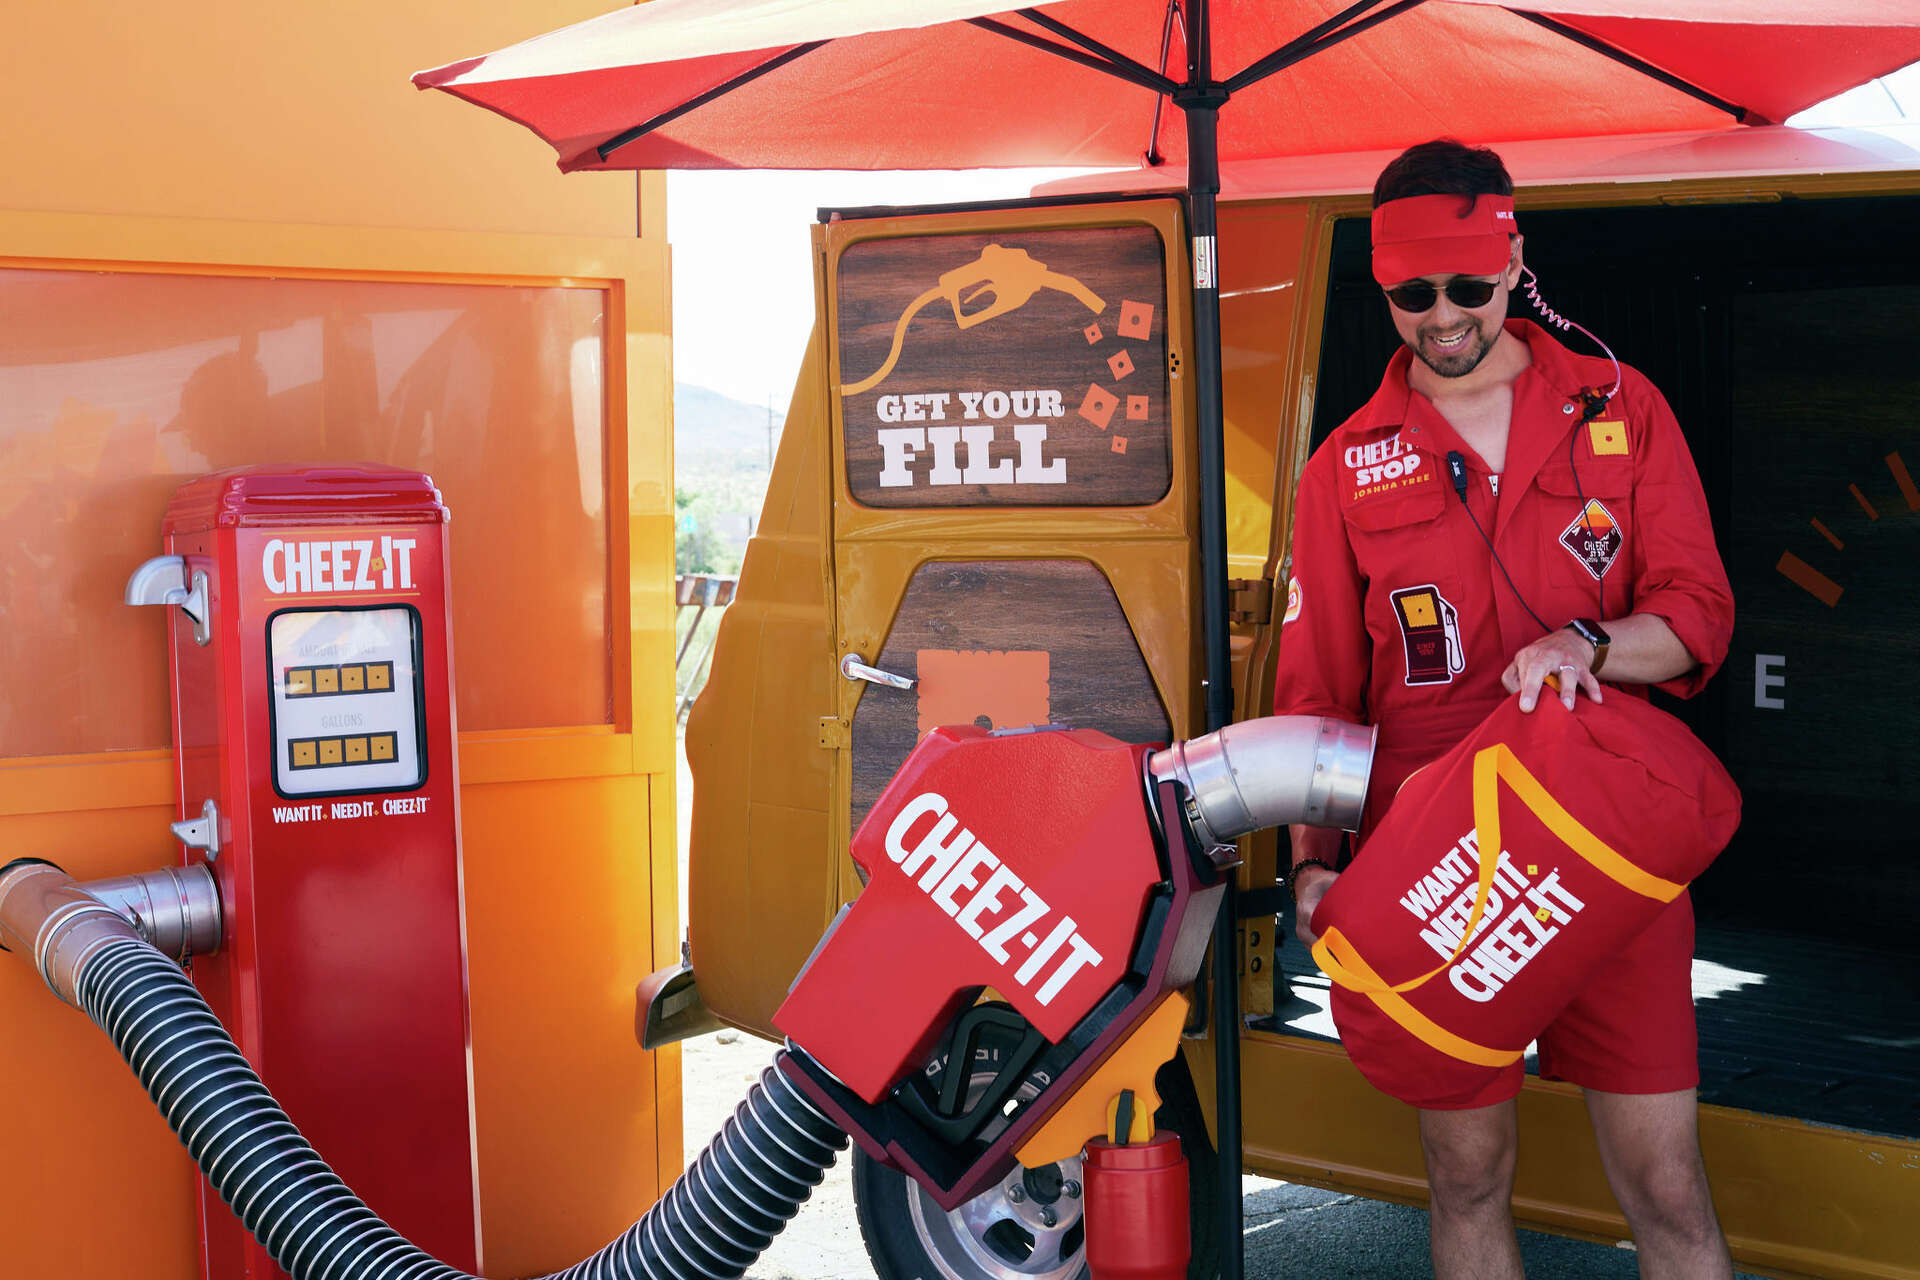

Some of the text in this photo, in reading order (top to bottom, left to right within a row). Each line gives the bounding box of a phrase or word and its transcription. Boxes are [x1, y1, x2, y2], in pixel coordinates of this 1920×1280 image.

[877, 390, 1065, 422] GET YOUR
[878, 424, 1067, 487] FILL
[1356, 454, 1421, 486] STOP
[1353, 473, 1429, 501] JOSHUA TREE
[1755, 654, 1785, 709] E
[321, 713, 363, 729] GALLONS
[272, 806, 311, 824] WANT
[331, 801, 362, 820] NEED
[885, 792, 1103, 1007] CHEEZ-IT
[1399, 846, 1473, 922] WANT
